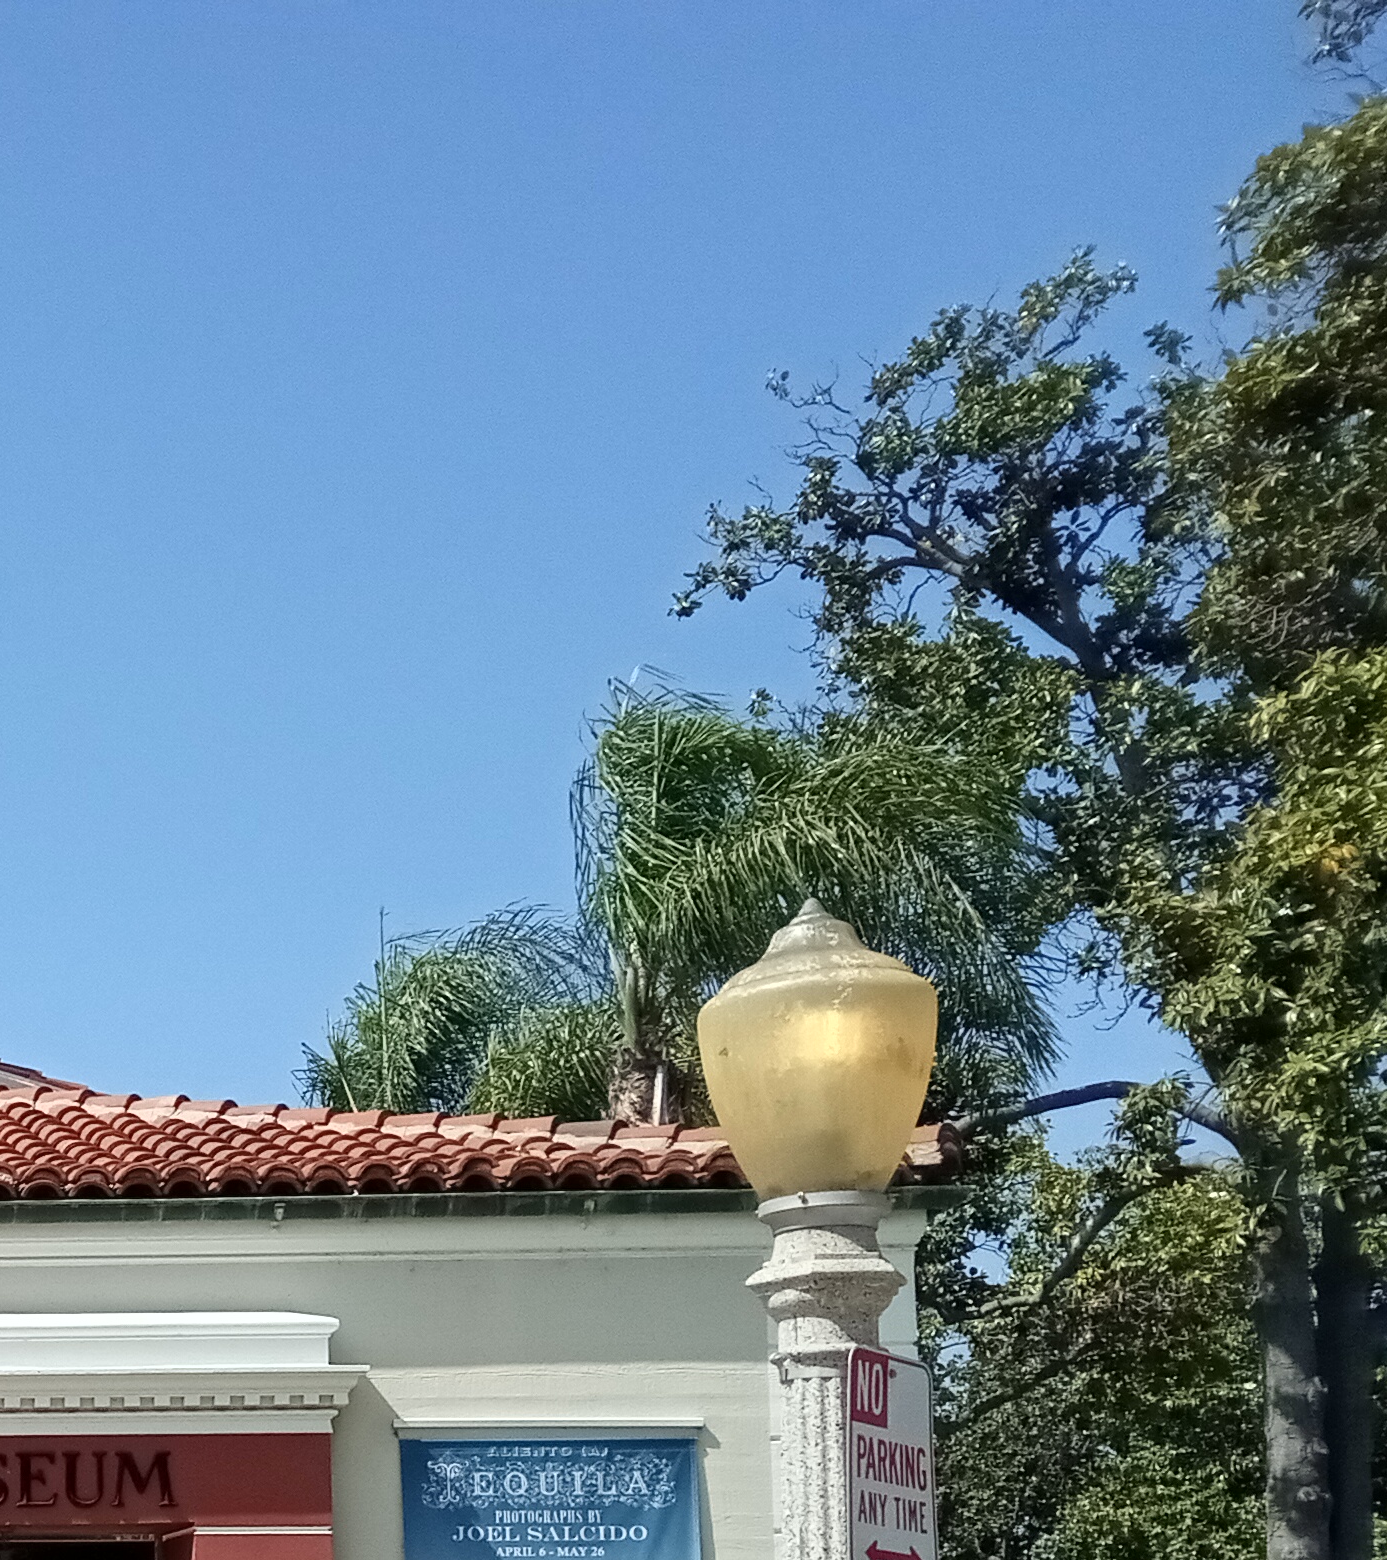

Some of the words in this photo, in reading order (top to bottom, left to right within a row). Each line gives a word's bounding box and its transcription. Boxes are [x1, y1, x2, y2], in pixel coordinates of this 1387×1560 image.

[856, 1359, 884, 1416] NO
[426, 1460, 650, 1503] TEQUILA
[856, 1433, 927, 1492] PARKING
[452, 1526, 521, 1542] JOEL
[527, 1525, 648, 1542] SALCIDO
[494, 1510, 583, 1524] PHOTOGRAPHS
[588, 1510, 603, 1524] BY
[858, 1490, 888, 1527] ANY
[894, 1497, 928, 1534] TIME
[496, 1546, 537, 1557] APRIL
[539, 1547, 546, 1557] 6
[557, 1546, 587, 1557] MAY
[590, 1547, 605, 1557] 26
